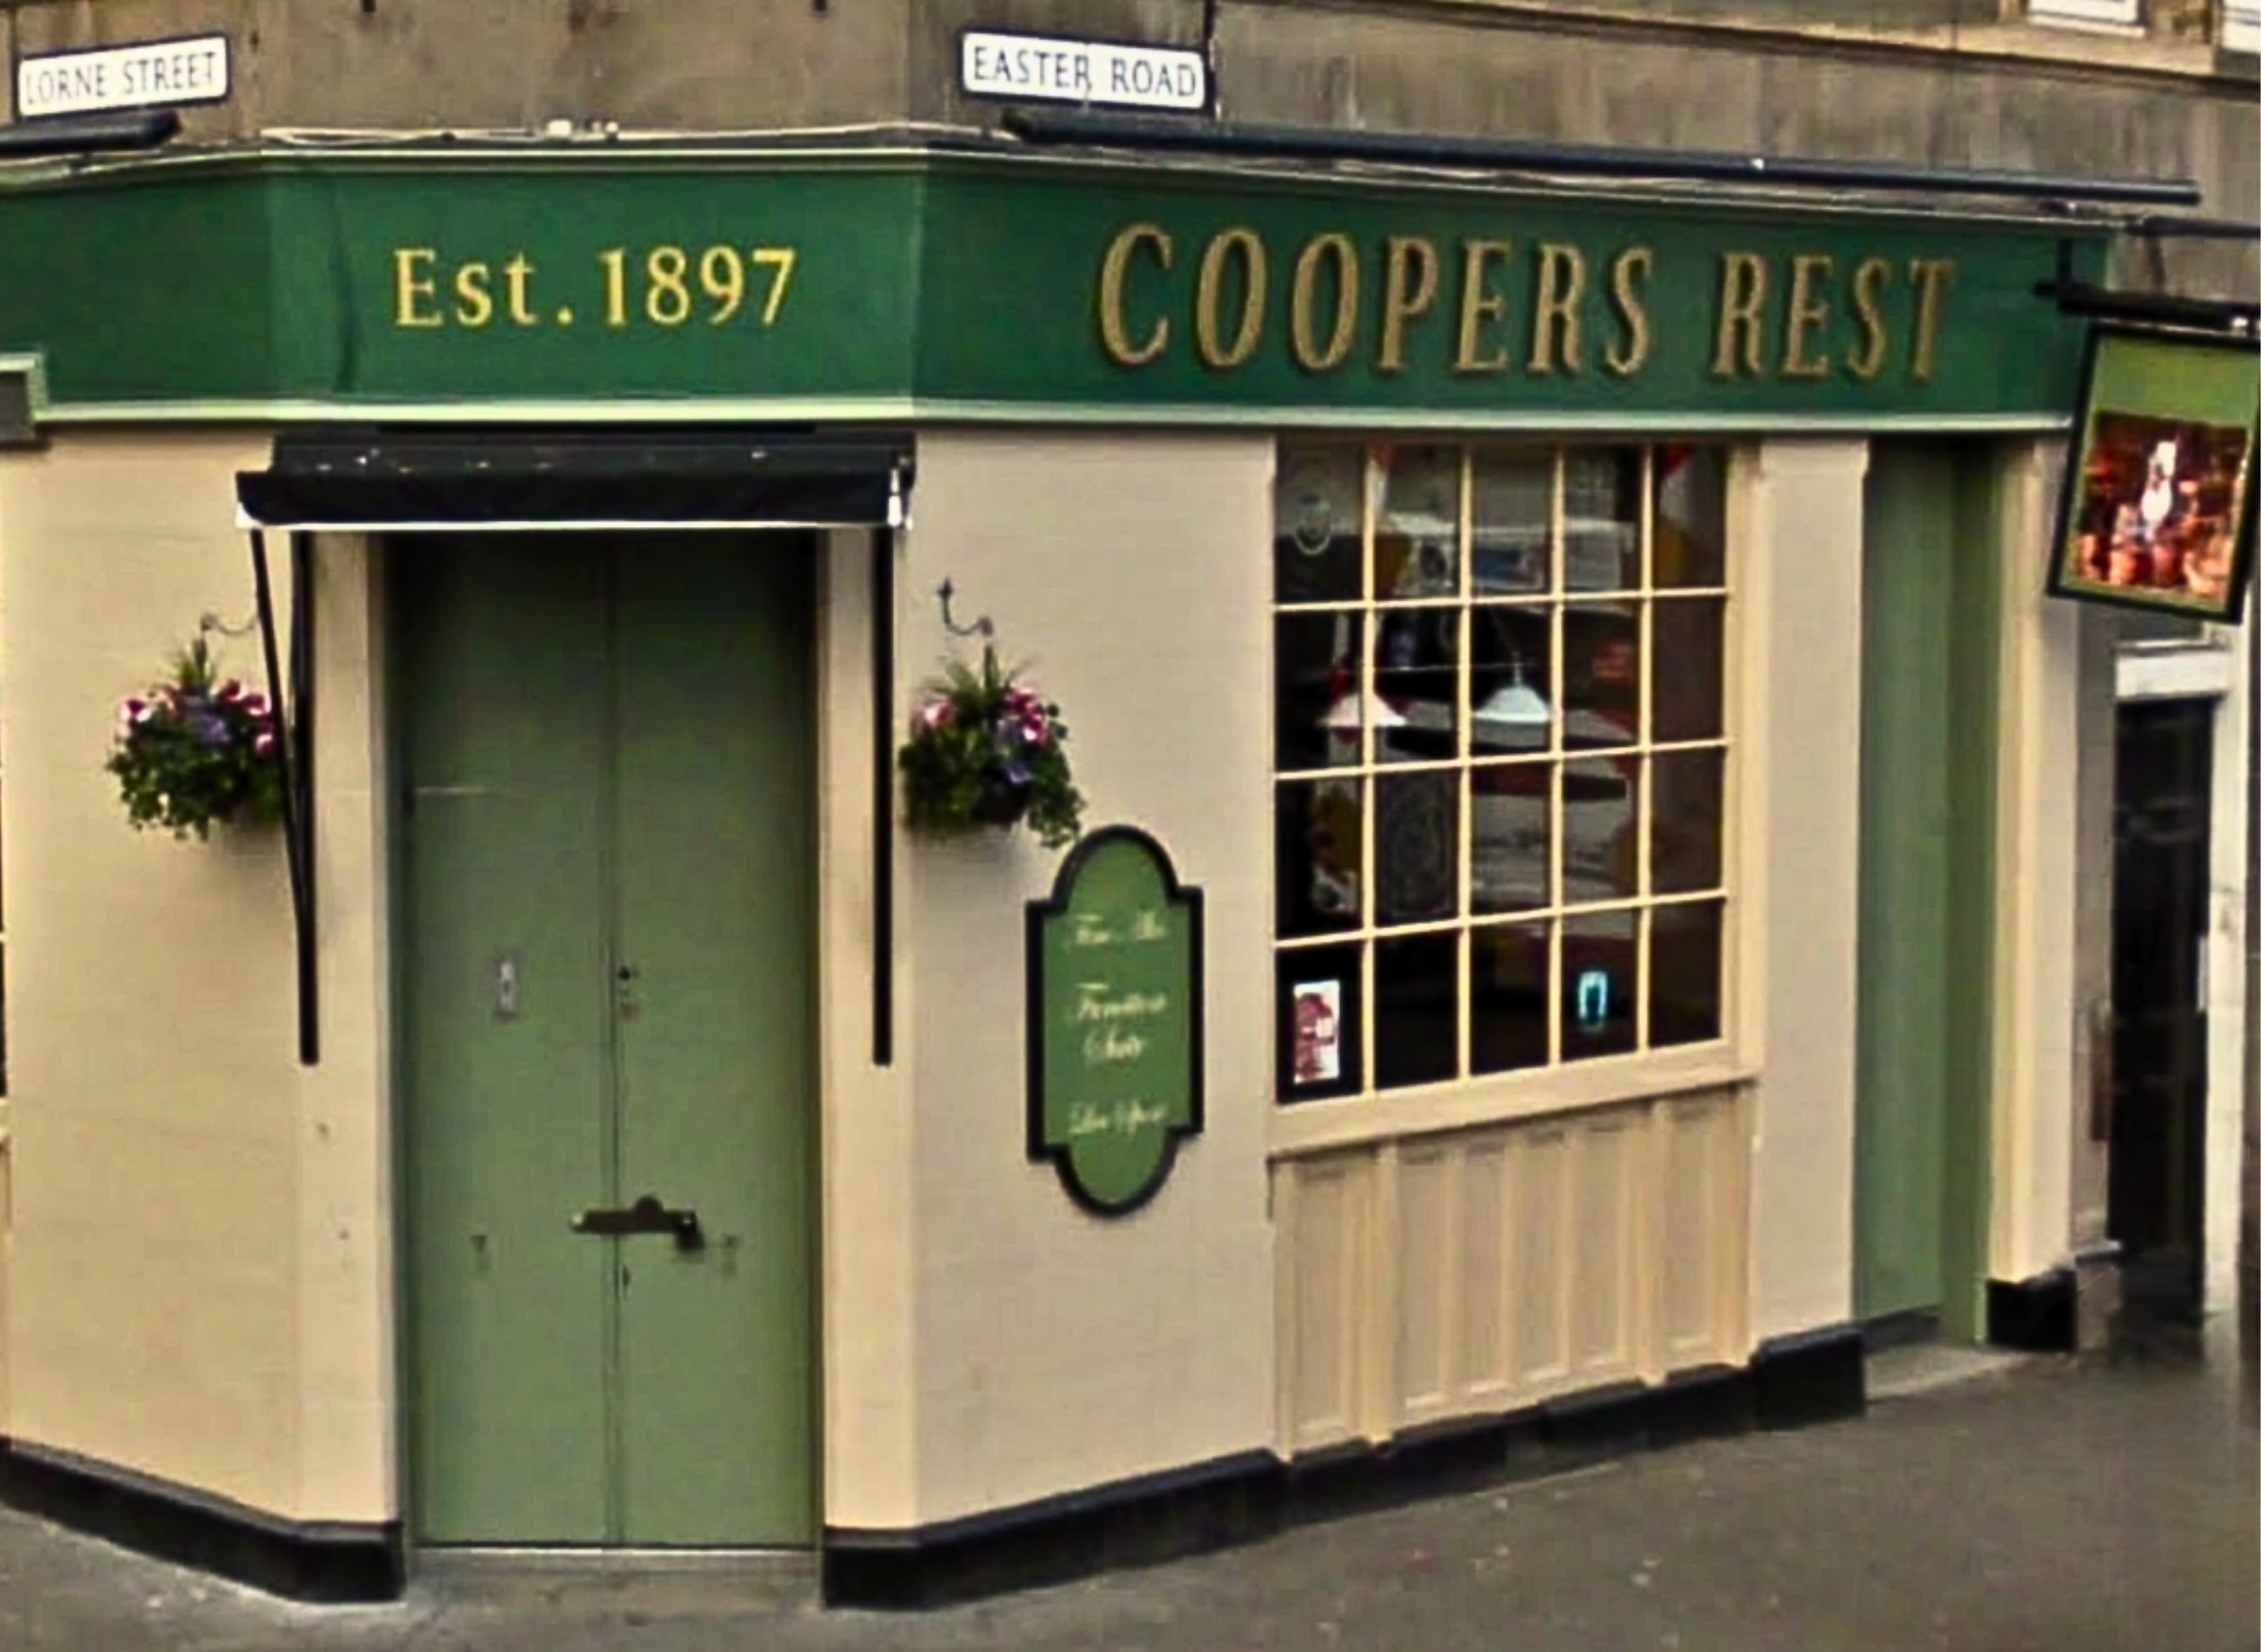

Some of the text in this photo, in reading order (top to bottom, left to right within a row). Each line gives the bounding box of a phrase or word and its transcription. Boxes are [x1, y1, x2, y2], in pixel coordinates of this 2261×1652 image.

[26, 51, 216, 104] LORNE STREET
[974, 46, 1196, 97] EASTER ROAD
[393, 245, 796, 327] Est. 1897
[1100, 223, 1956, 379] COOPERS REST
